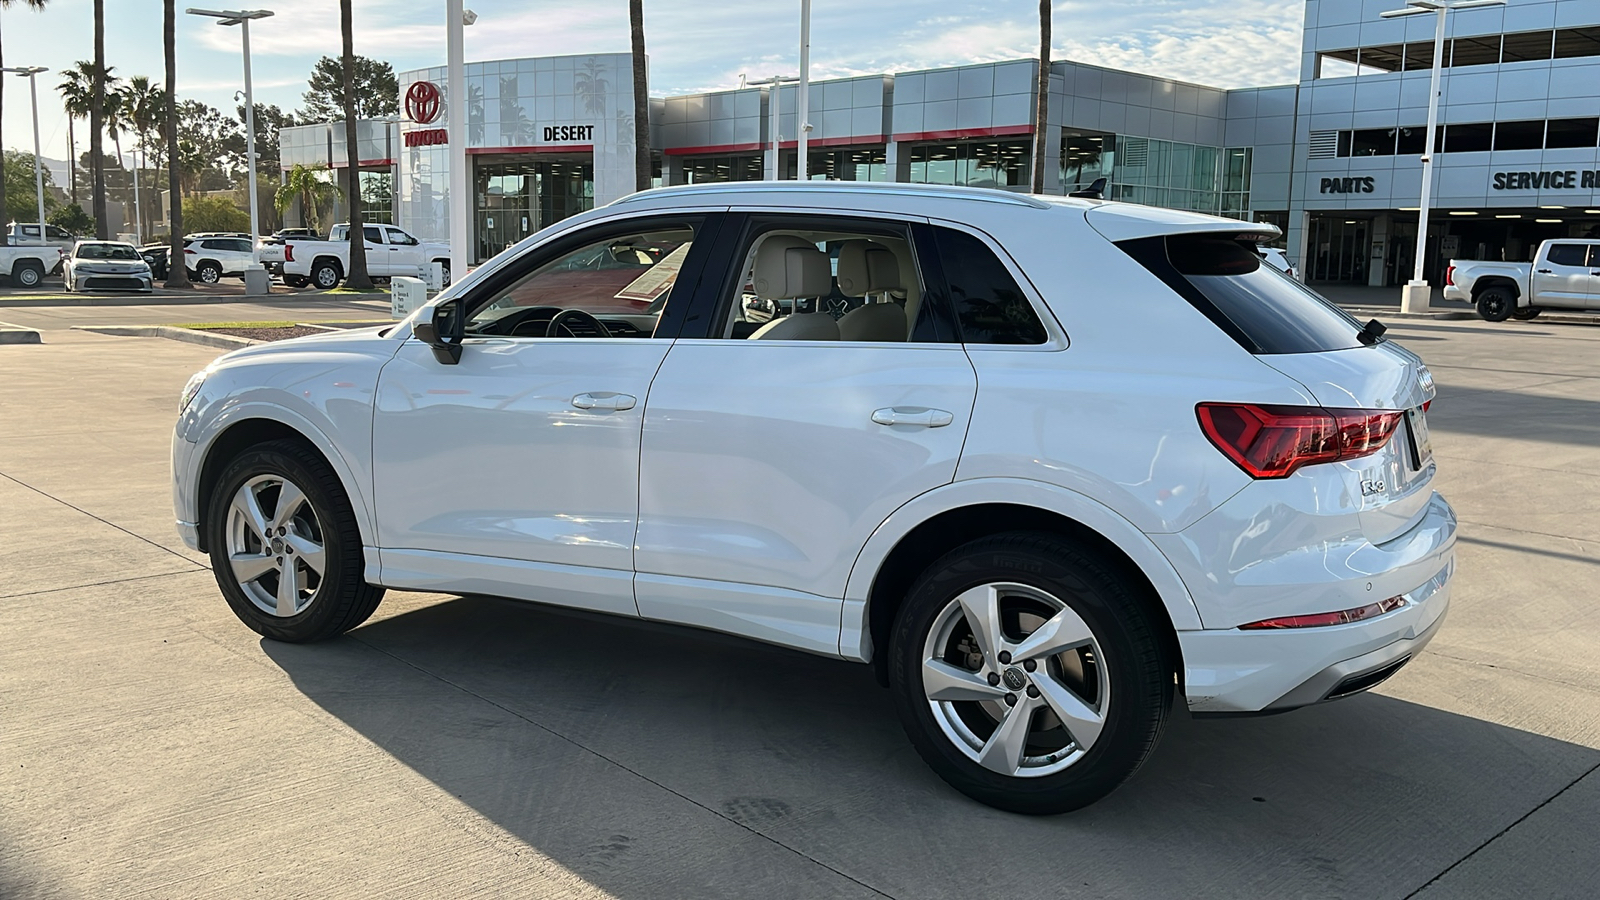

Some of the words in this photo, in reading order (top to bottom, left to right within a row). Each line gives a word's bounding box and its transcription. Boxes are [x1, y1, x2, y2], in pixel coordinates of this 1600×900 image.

[403, 129, 448, 147] TOYOTA
[543, 125, 594, 142] DESERT
[1320, 177, 1375, 193] PARTS
[1493, 170, 1577, 190] SERVICE
